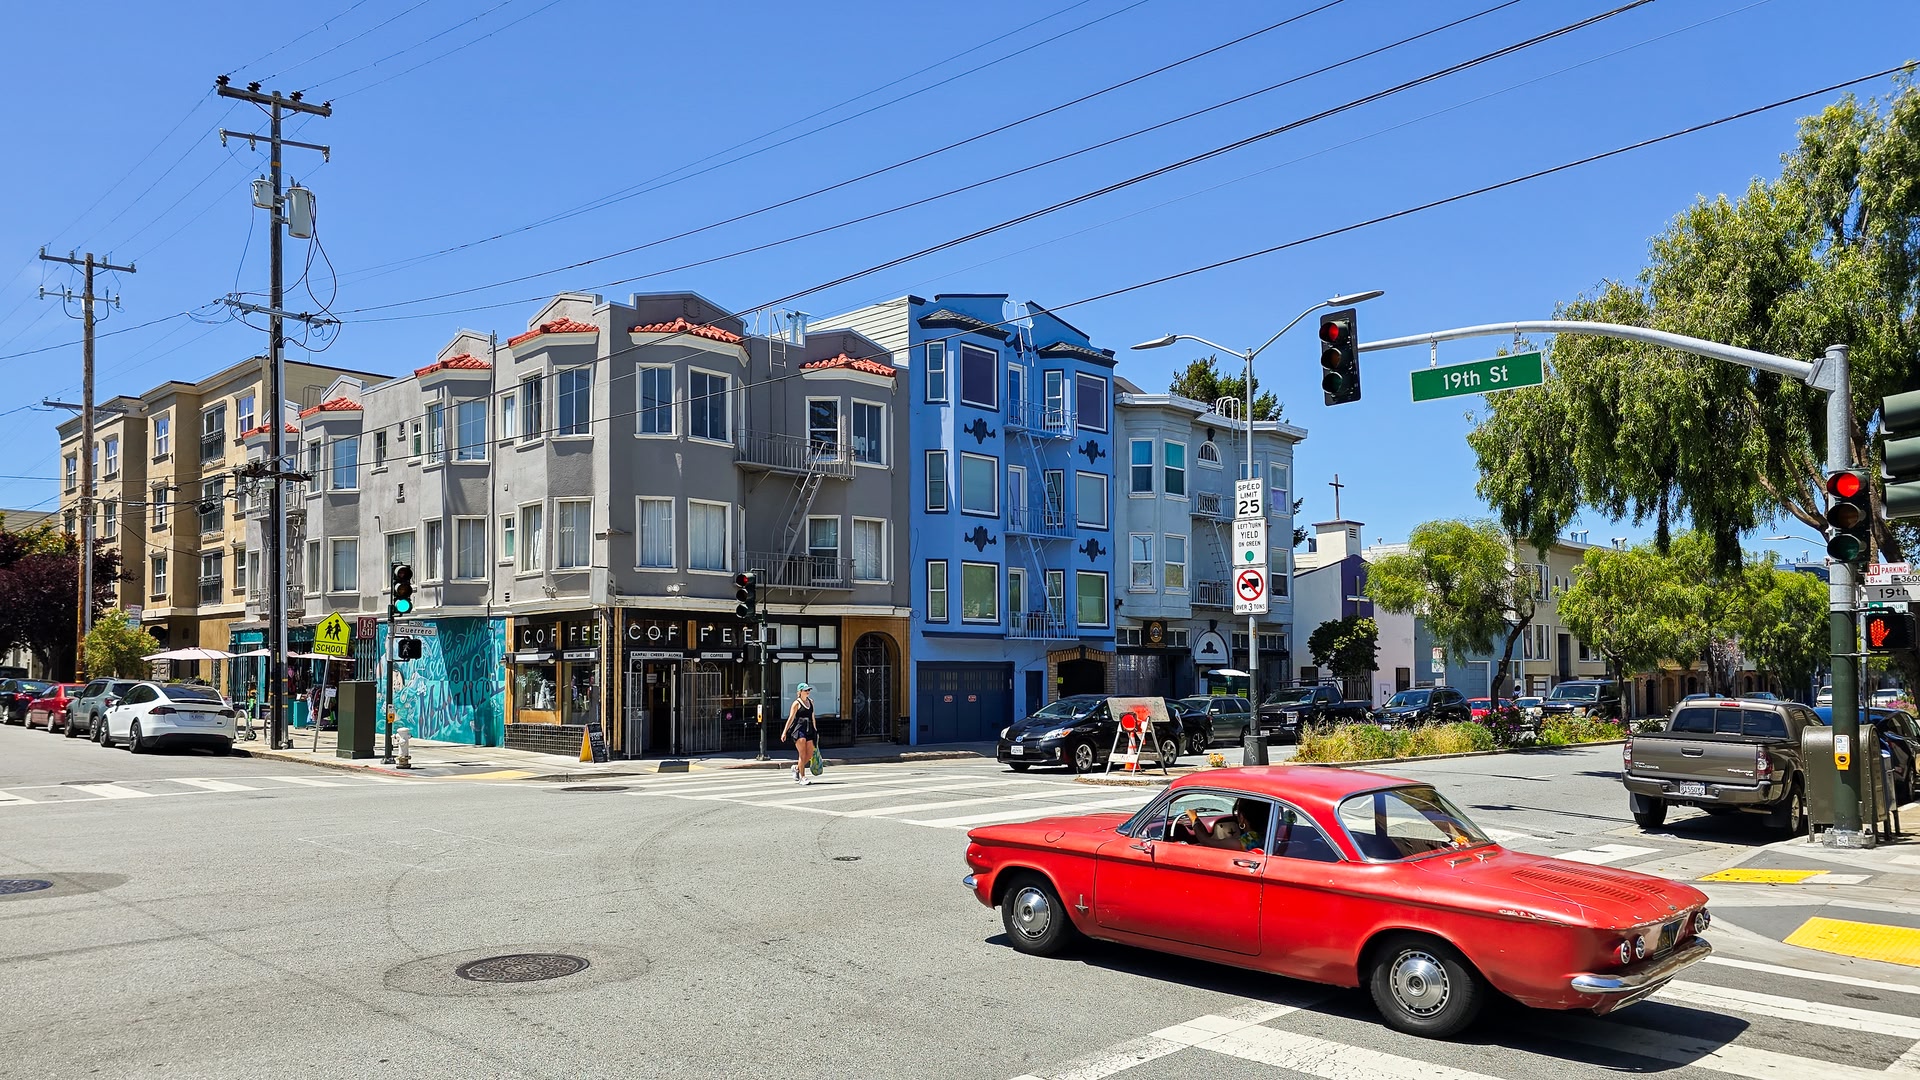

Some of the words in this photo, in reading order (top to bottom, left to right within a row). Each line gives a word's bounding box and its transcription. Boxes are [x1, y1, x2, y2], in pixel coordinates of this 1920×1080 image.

[1443, 370, 1481, 390] 19th
[1490, 365, 1509, 383] St
[1238, 483, 1260, 491] SPEED
[1240, 491, 1258, 499] LIMIT
[1239, 500, 1260, 514] 25
[1240, 531, 1259, 539] YIELD
[1881, 566, 1908, 574] PARKING
[1879, 588, 1909, 599] 19th
[1248, 602, 1253, 611] 3
[399, 626, 433, 635] Guerrero
[628, 624, 753, 643] COFFEE
[315, 643, 345, 654] SCHOOL
